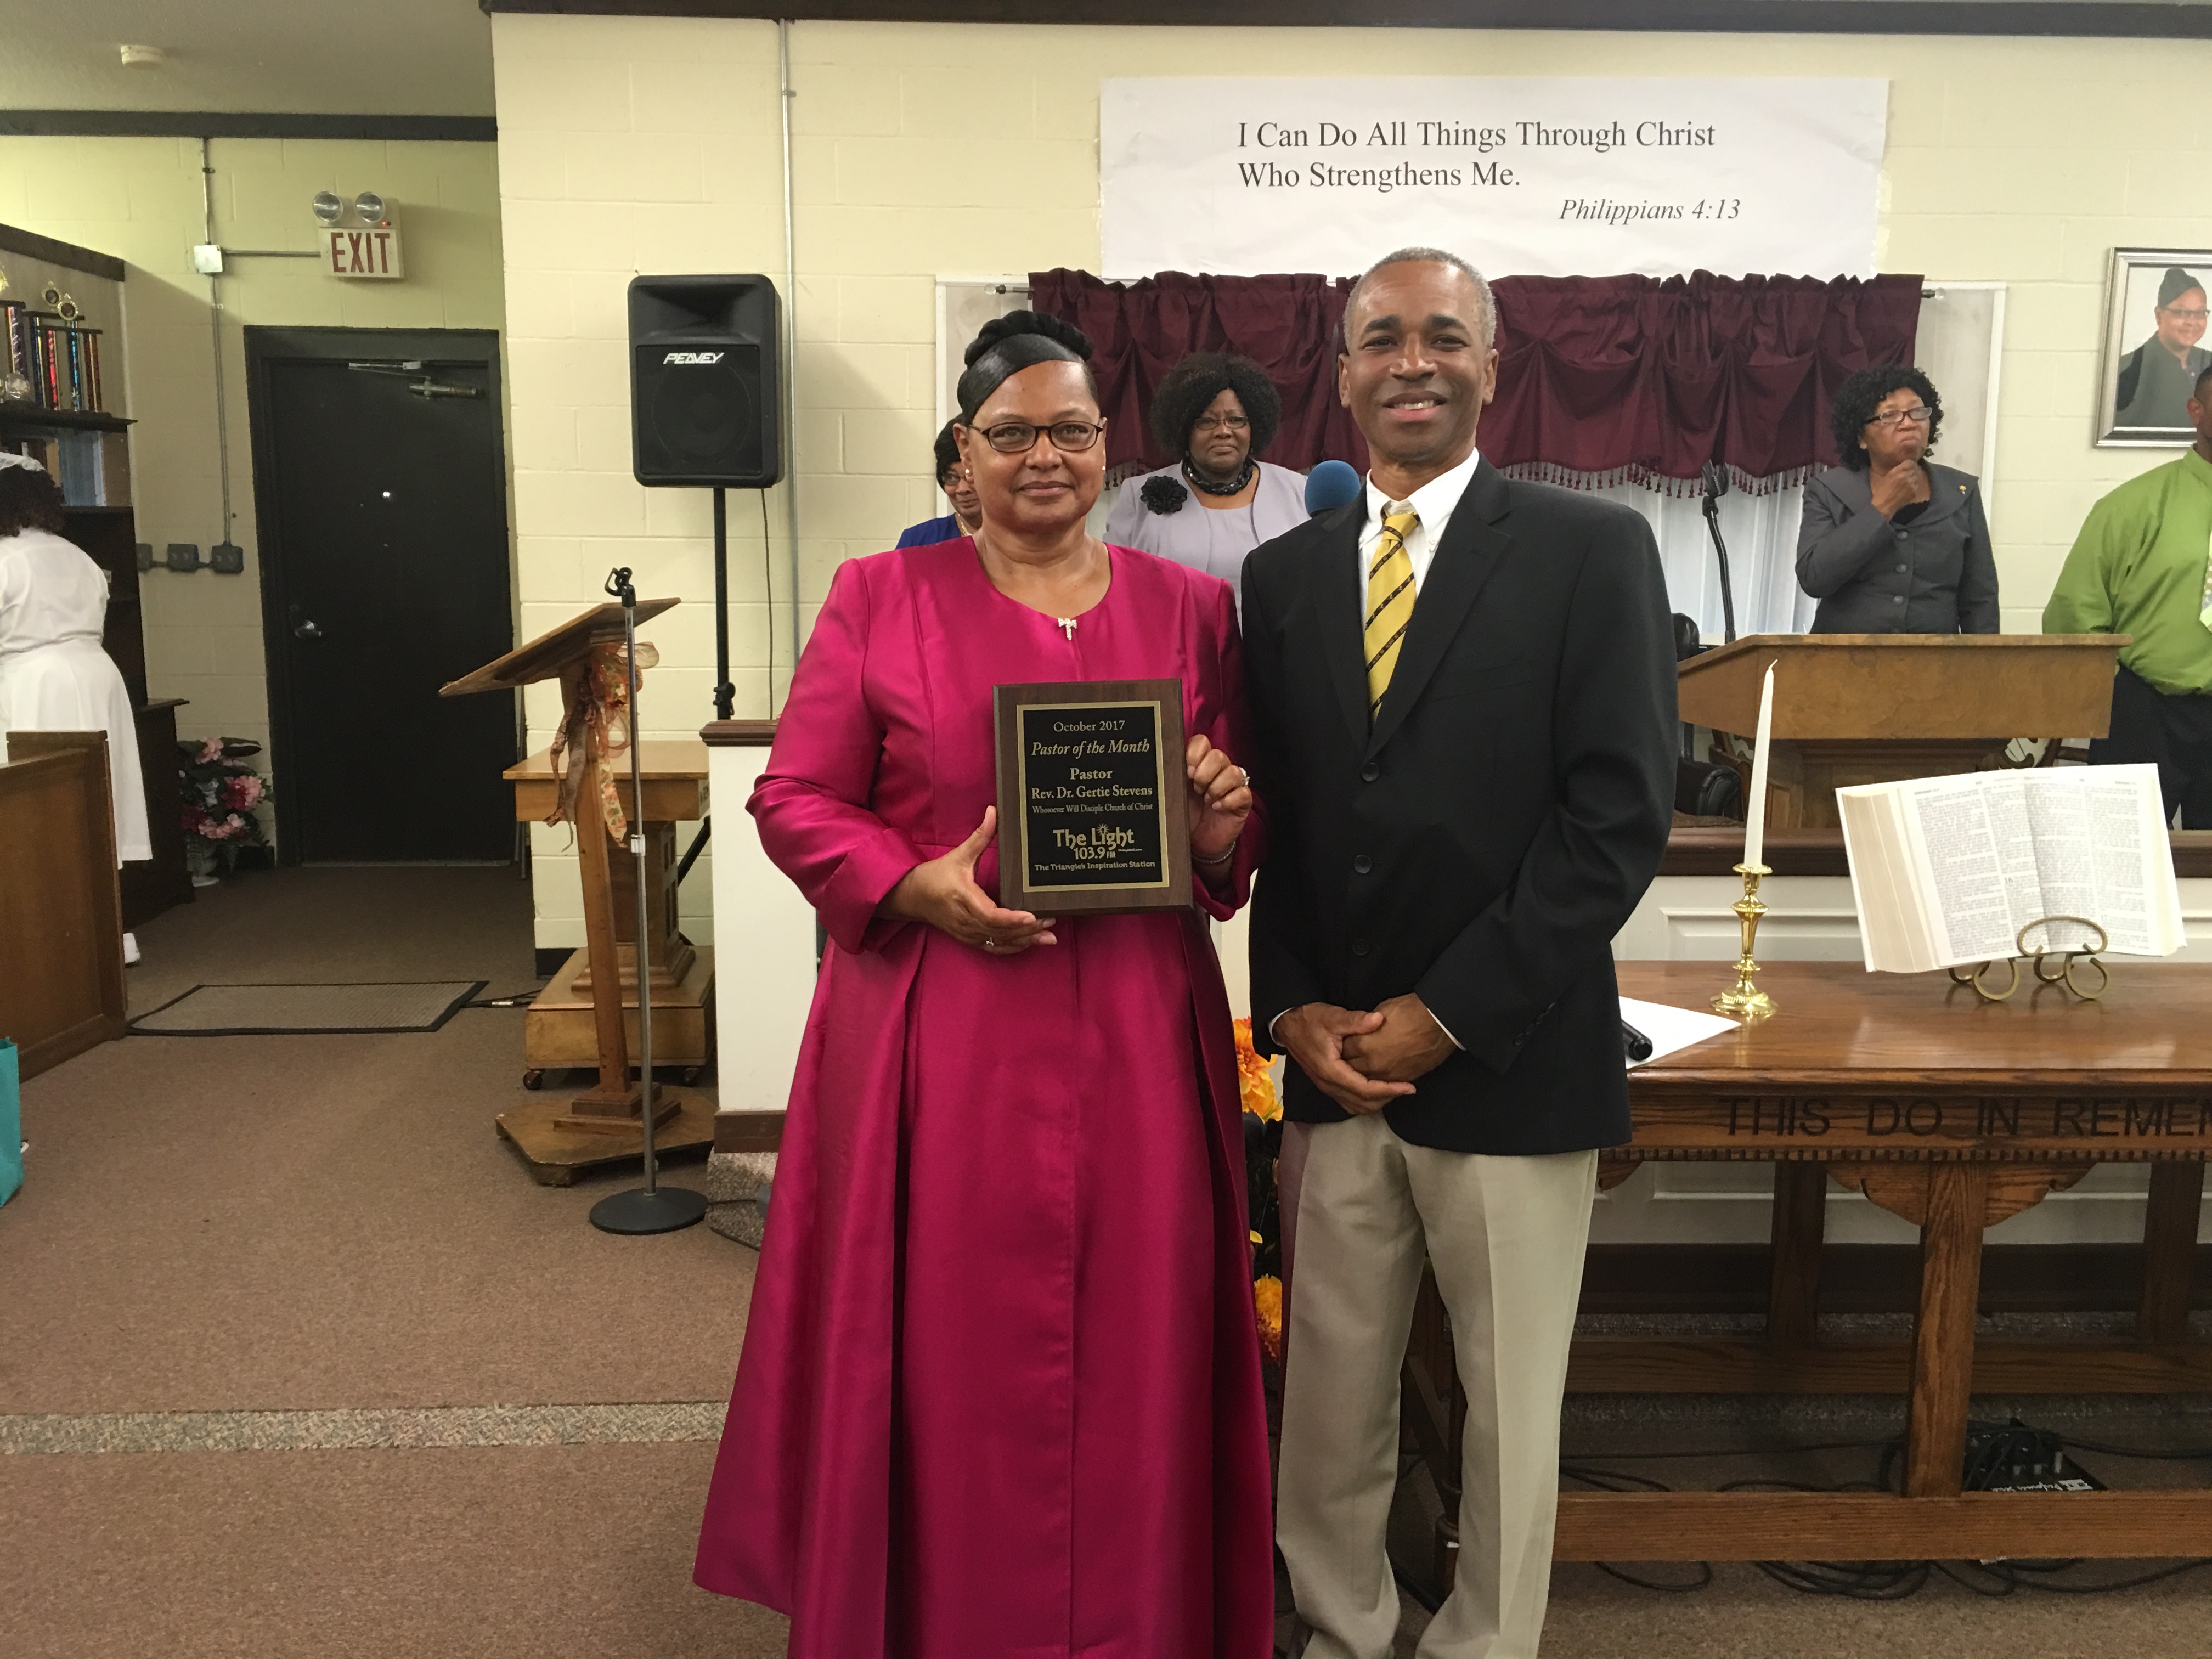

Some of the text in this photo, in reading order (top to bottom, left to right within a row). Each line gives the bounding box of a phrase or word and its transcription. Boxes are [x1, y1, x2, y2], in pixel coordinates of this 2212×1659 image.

[1237, 120, 1716, 153] I Can Do All Things Through Christ
[1237, 161, 1520, 193] Who Strengthens Me.
[1558, 199, 1741, 225] Philippians 4:13
[330, 232, 391, 273] EXIT
[663, 352, 725, 364] PEAVEY
[1053, 720, 1126, 732] October 2017
[1031, 738, 1150, 760] Pastor of the Month
[1069, 768, 1113, 780] Pastor
[1031, 784, 1153, 799] Rev. Dr. Gertie Stevens
[1032, 802, 1153, 814] Whosoever Will Disciple Church of Christ
[1052, 825, 1135, 851] The Light
[1073, 847, 1105, 860] 103.9
[1106, 851, 1116, 859] FM
[1050, 862, 1086, 872] Triangle's
[1087, 861, 1128, 871] Inspiration
[1718, 1097, 1831, 1137] THIS
[1866, 1097, 1943, 1136] DO
[1976, 1097, 2021, 1136] IN
